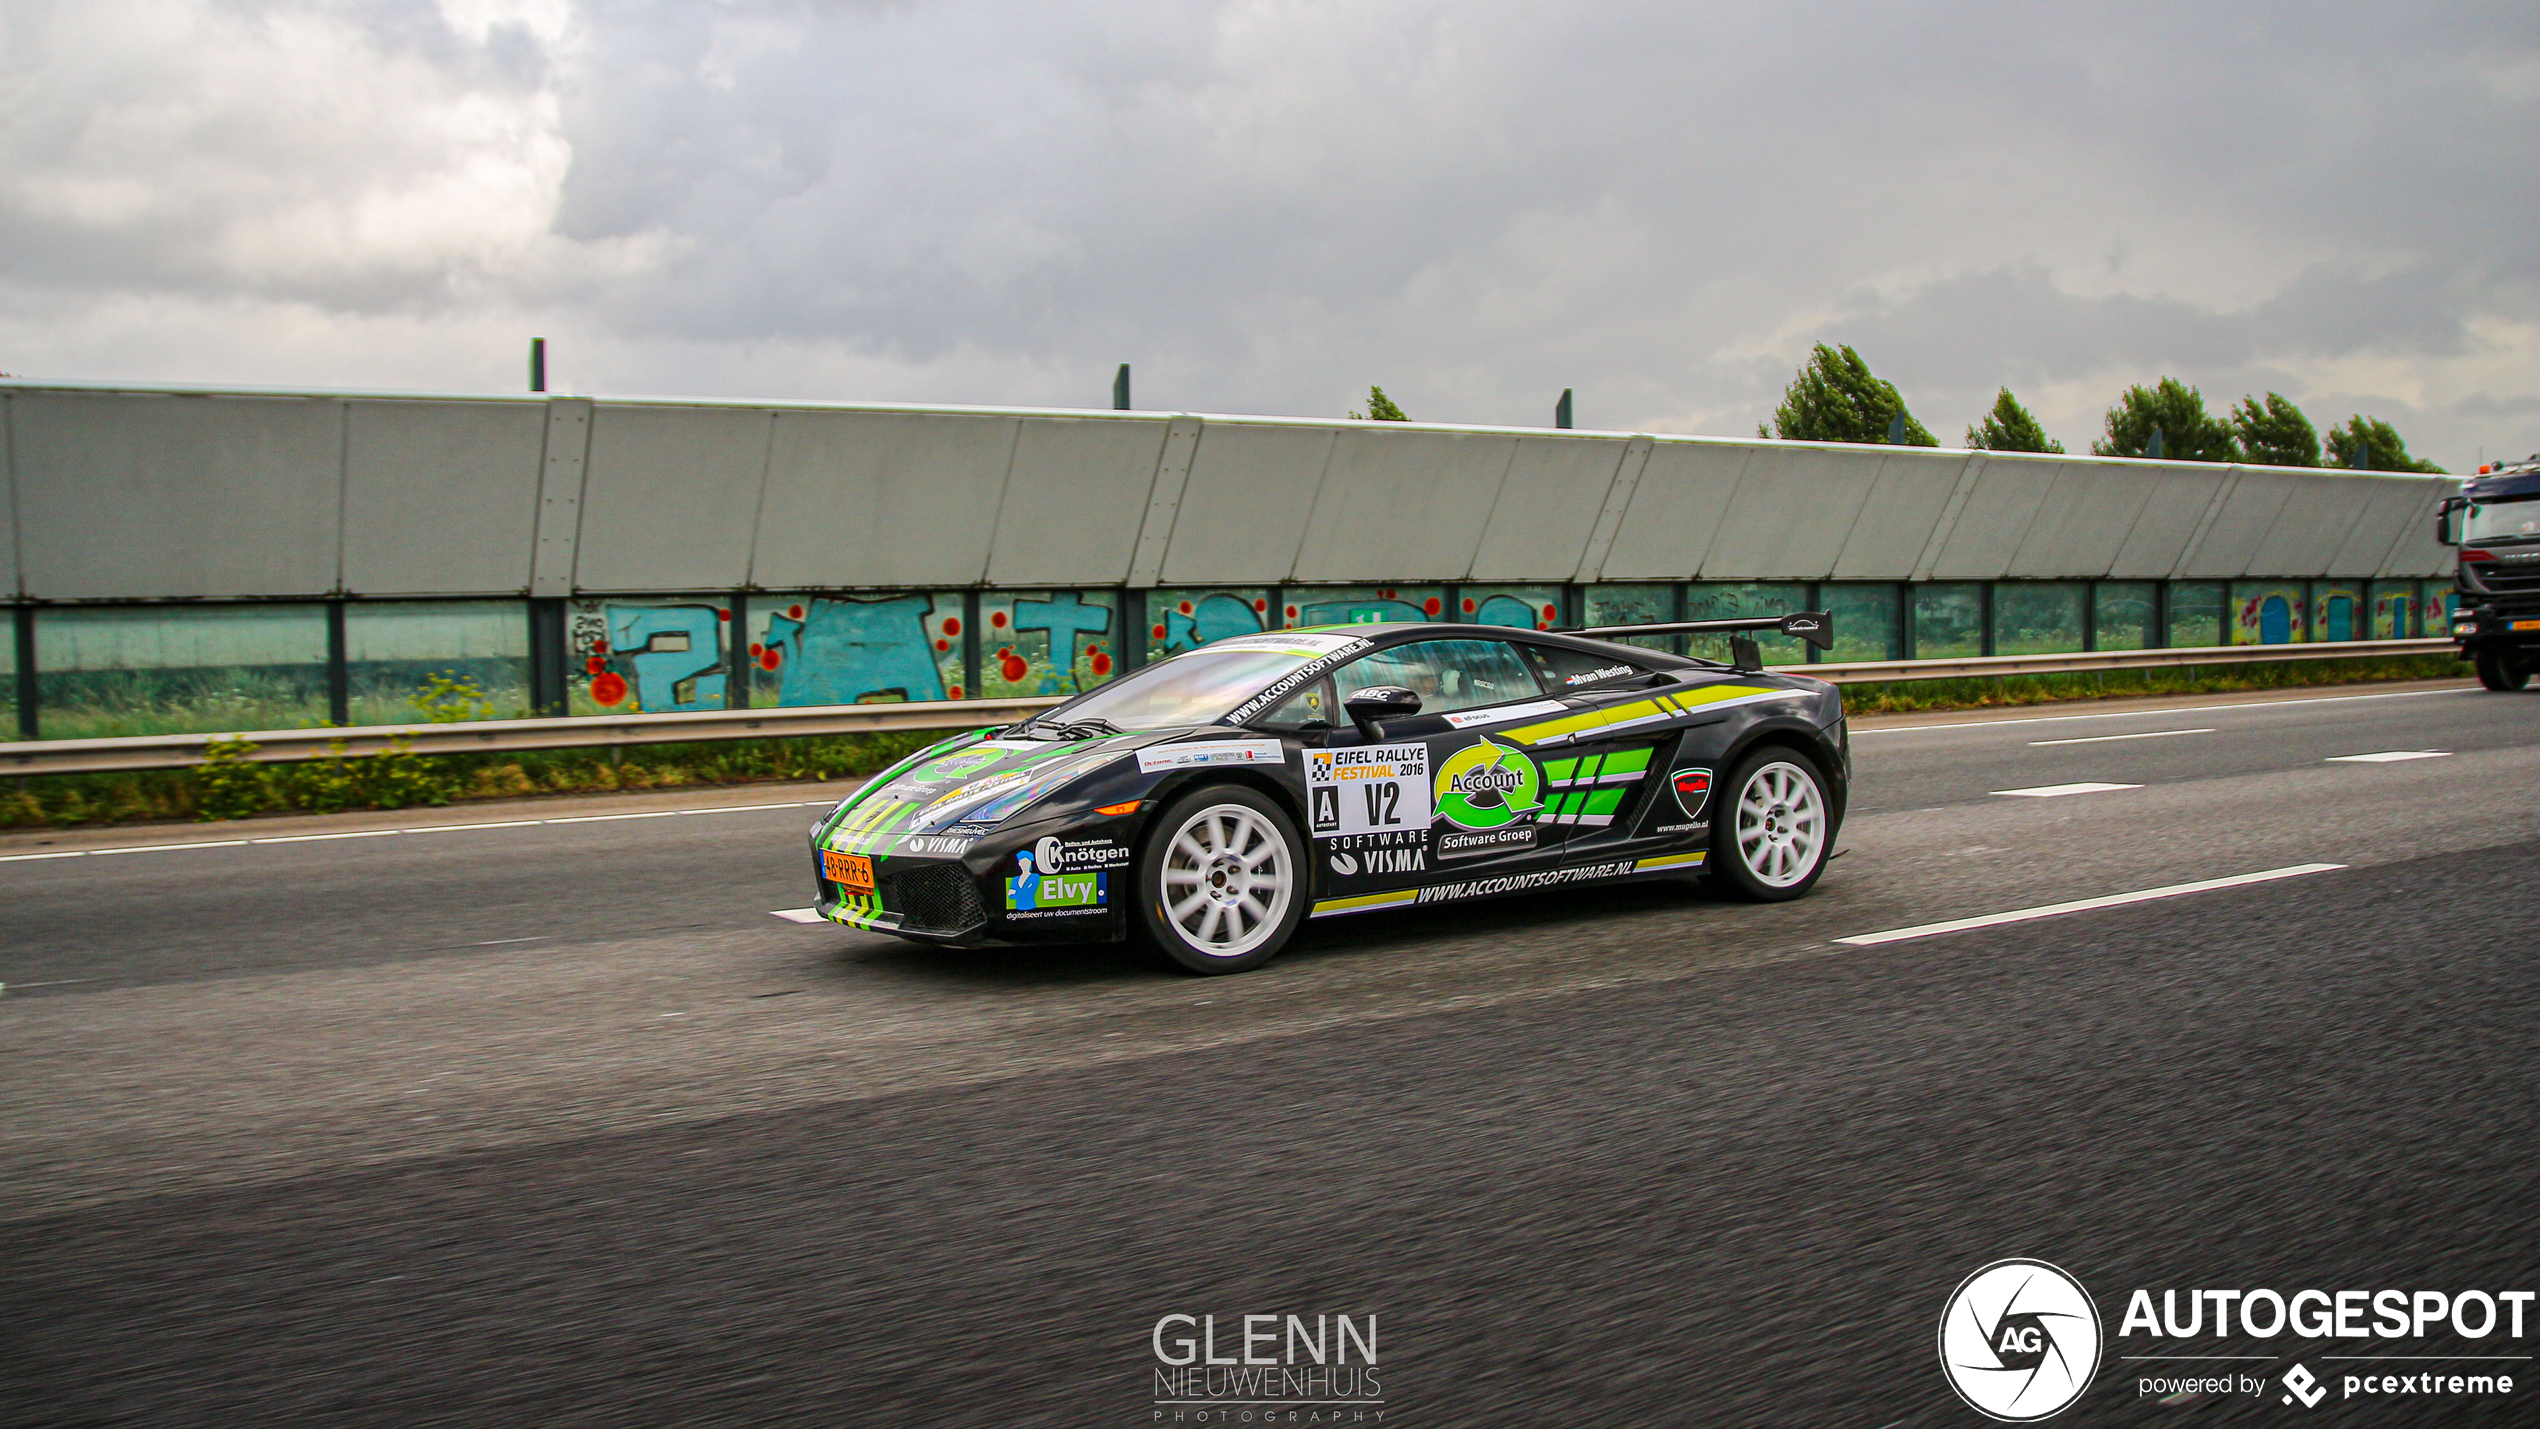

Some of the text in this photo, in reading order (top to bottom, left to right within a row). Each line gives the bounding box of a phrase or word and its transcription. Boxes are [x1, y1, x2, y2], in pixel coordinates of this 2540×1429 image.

[1226, 638, 1375, 725] WWW.ACCOUNTSOFTWARE.NL
[1570, 665, 1634, 686] Mvan Westing
[1351, 689, 1391, 699] ABC
[1335, 748, 1425, 765] EIFEL RALLYE
[1333, 763, 1424, 780] FESTIVAL 2016
[1450, 769, 1524, 792] Account
[1677, 778, 1708, 793] Mugello
[1318, 791, 1335, 822] A
[1364, 781, 1401, 826] V2
[1657, 820, 1708, 832] www.mugello.nl
[926, 837, 968, 854] VISMA
[1330, 830, 1428, 851] SOFTWARE
[1443, 829, 1533, 849] Software Groep
[1049, 845, 1129, 864] Knötgen
[1363, 848, 1426, 874] VISMA
[825, 855, 869, 883] 48-RRR-6
[1043, 877, 1093, 904] Elvy
[1417, 861, 1635, 905] WWW.ACCOUNTSOFTWARE.NL
[1006, 911, 1043, 921] digitaliseert
[1055, 907, 1108, 917] documentstroom
